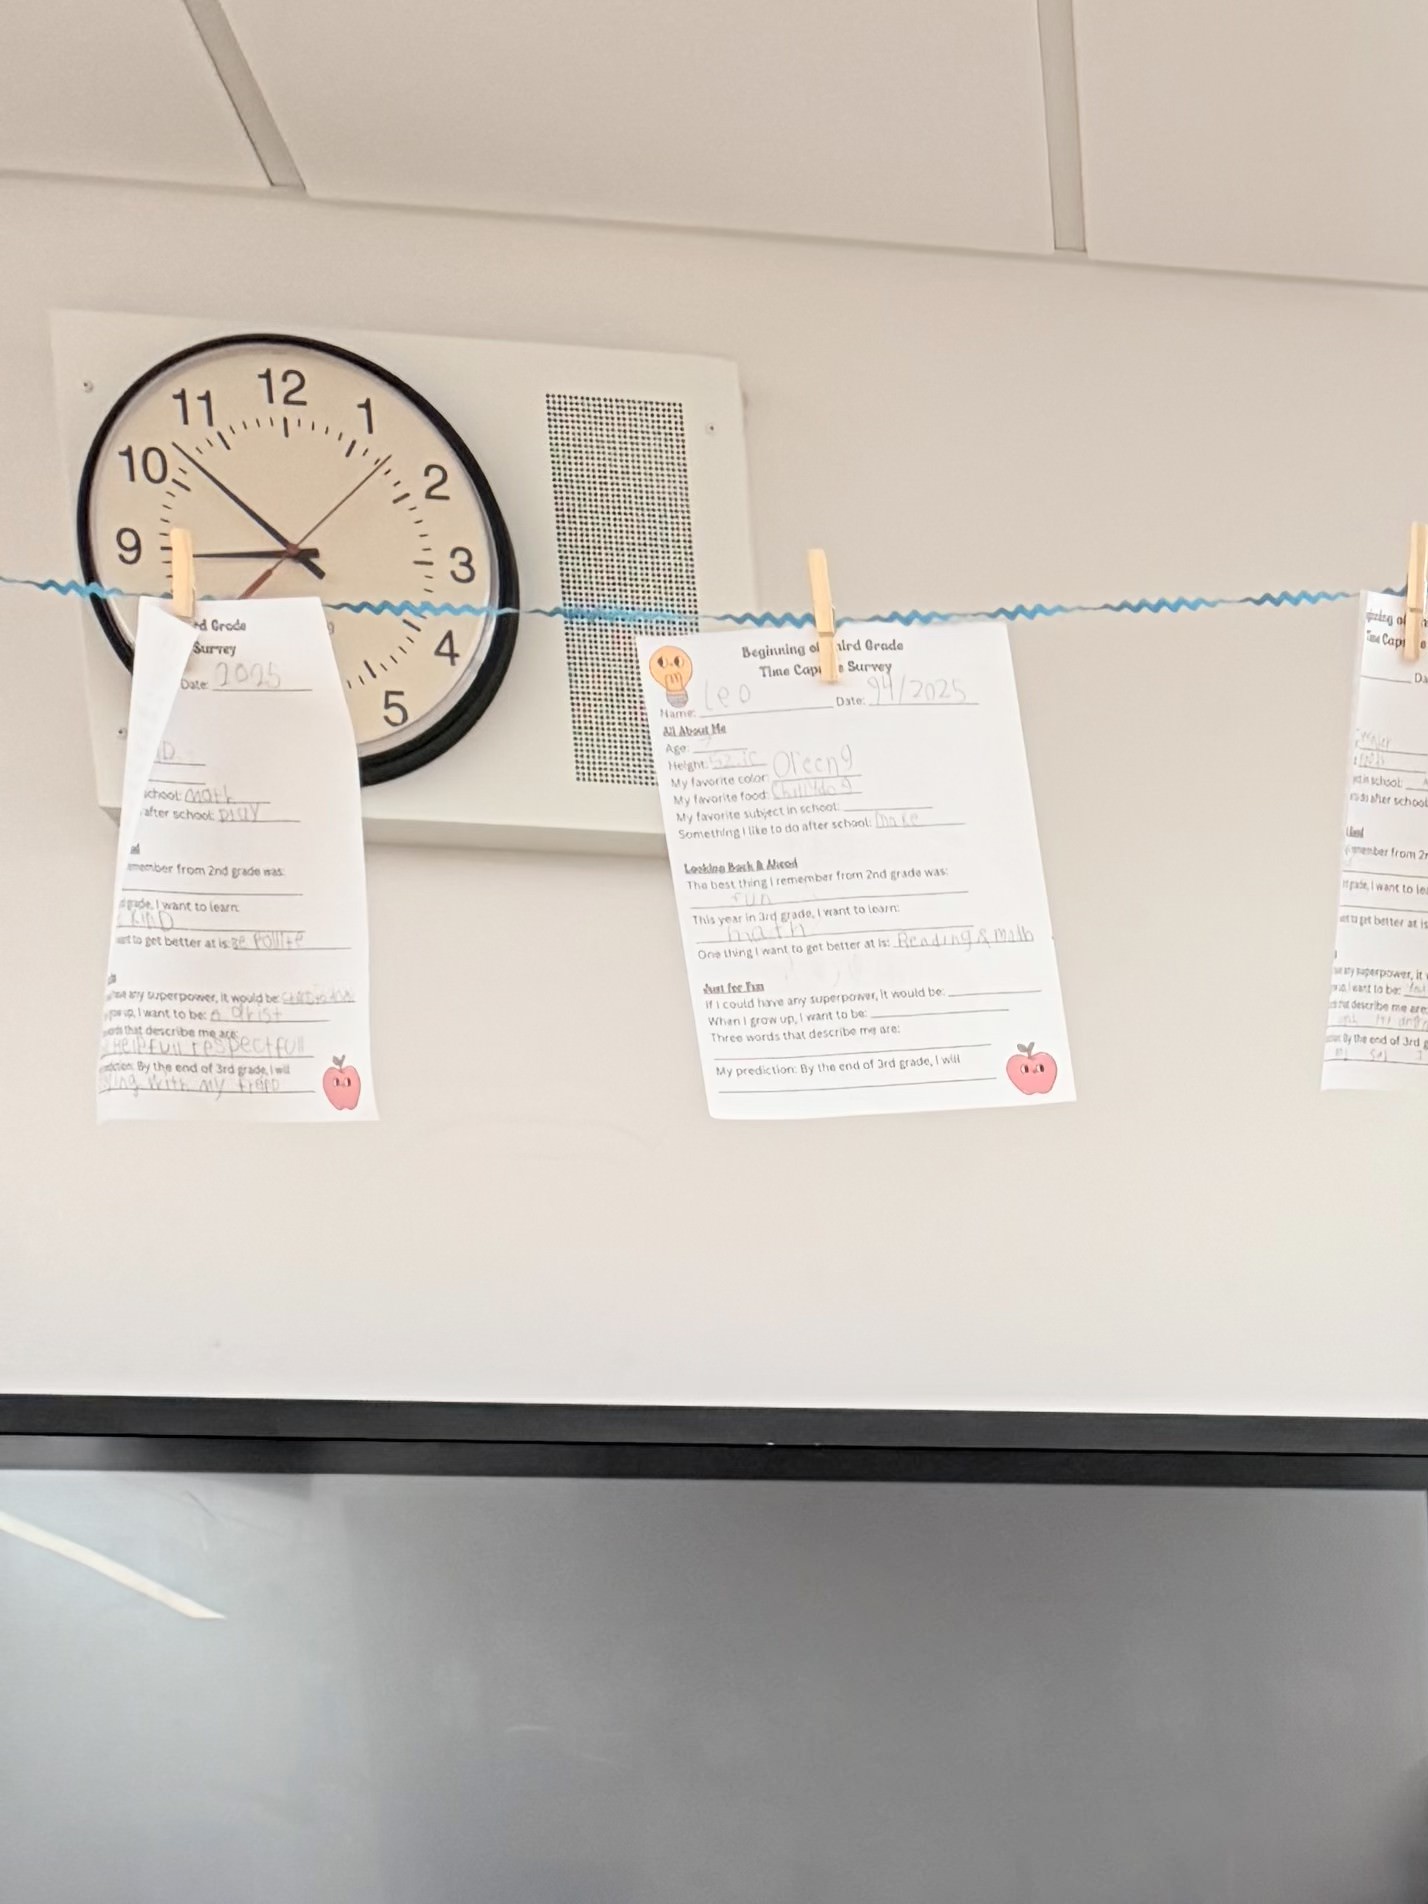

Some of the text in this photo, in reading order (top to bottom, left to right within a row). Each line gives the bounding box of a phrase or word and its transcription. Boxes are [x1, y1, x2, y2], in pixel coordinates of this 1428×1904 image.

[258, 369, 308, 406] 12
[171, 388, 215, 427] 11
[356, 398, 375, 434] 1
[118, 445, 169, 485] 10
[424, 465, 450, 501] 2
[116, 526, 142, 565] 9
[450, 547, 476, 584] 3
[432, 630, 461, 666] 4
[742, 644, 805, 661] Beginning
[759, 665, 790, 679] Time
[848, 661, 893, 676] Survey
[382, 690, 409, 728] 5
